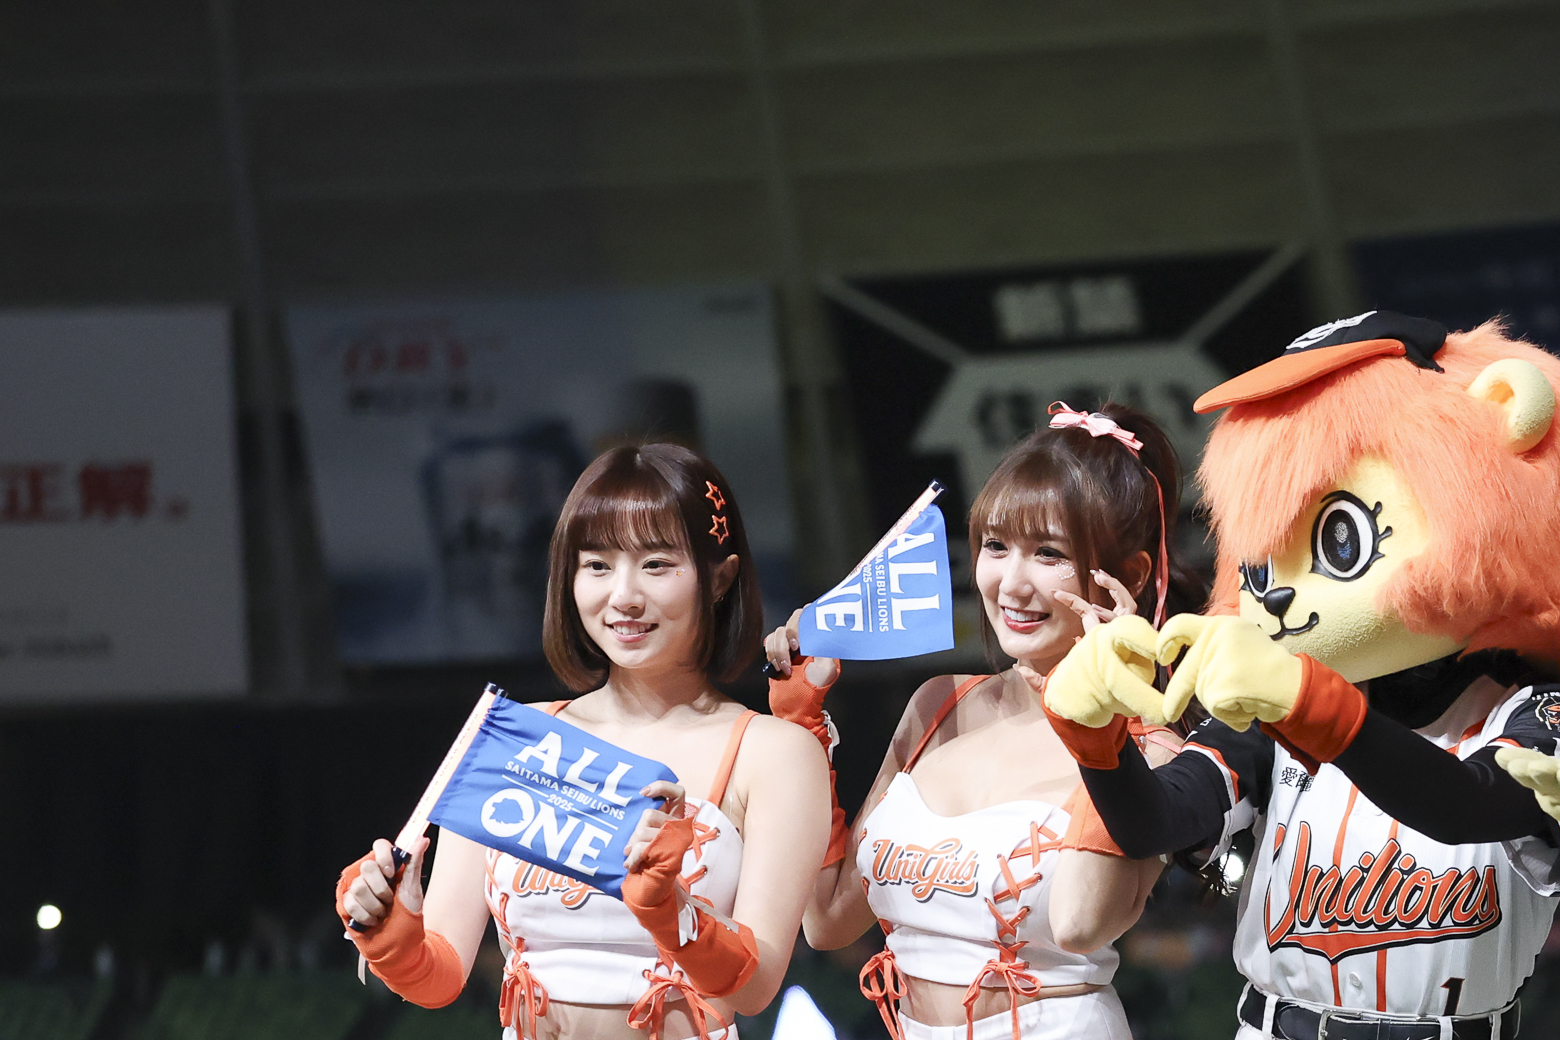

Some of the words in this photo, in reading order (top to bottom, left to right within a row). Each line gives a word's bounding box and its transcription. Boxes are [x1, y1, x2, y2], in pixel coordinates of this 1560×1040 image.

[815, 580, 864, 632] NE
[875, 564, 888, 596] SEIBU
[888, 532, 940, 631] ALL
[877, 599, 890, 633] LIONS
[504, 760, 560, 791] SAITAMA
[560, 785, 590, 808] SEIBU
[589, 800, 626, 821] LIONS
[513, 731, 634, 808] ALL
[480, 788, 614, 877] ONE
[549, 793, 573, 812] 2025
[872, 837, 979, 904] UniGirls
[1264, 820, 1502, 956] Unilions
[1440, 976, 1466, 1016] 1
